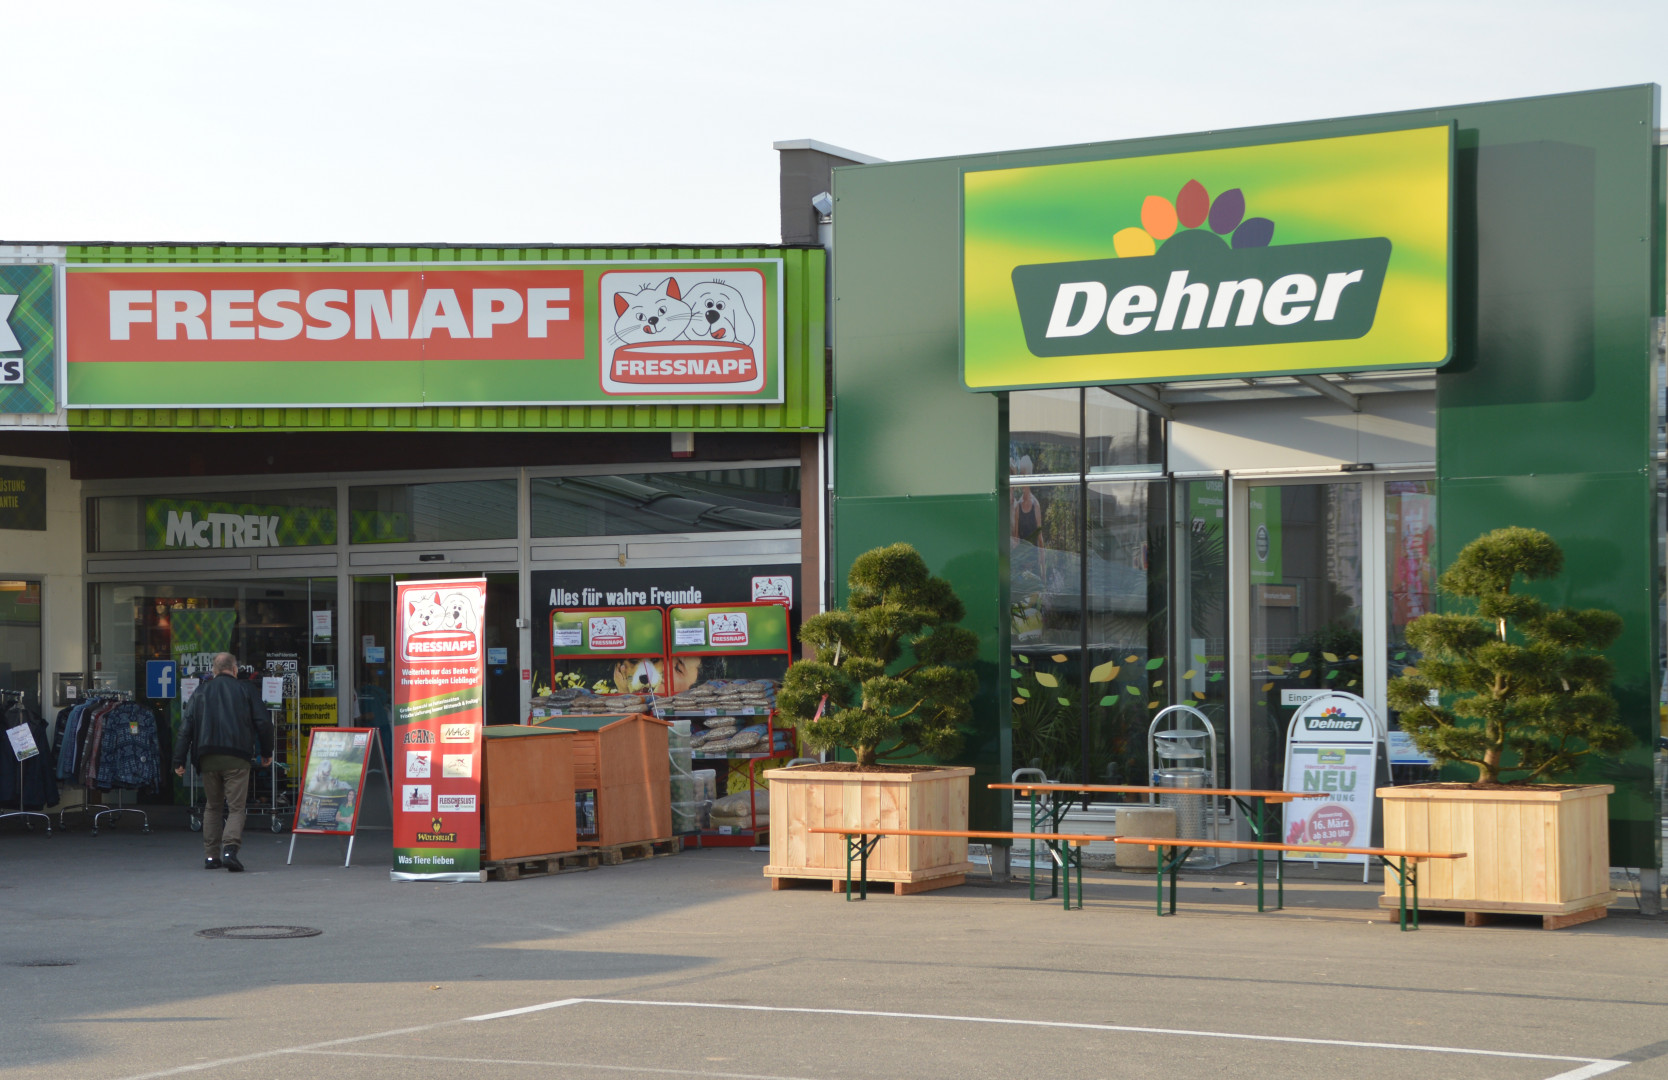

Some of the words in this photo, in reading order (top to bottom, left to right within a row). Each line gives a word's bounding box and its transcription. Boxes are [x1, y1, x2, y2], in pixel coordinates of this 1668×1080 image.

[1045, 269, 1364, 338] Dehner
[109, 288, 570, 340] FRESSNAPF
[615, 359, 752, 376] FRESSNAPF
[165, 510, 280, 548] McTREK
[549, 588, 579, 606] Alles
[582, 587, 602, 606] für
[606, 587, 646, 605] wahre
[650, 586, 702, 604] Freunde
[712, 635, 746, 643] FRESSNAPF
[408, 640, 475, 653] FRESSNAPF
[401, 668, 430, 676] Weiterhin
[441, 667, 451, 675] das
[453, 667, 468, 675] Beste
[1308, 718, 1360, 729] Dehner
[403, 729, 436, 745] ACANA
[1303, 769, 1357, 792] NEU
[1312, 820, 1326, 830] 16.
[1327, 818, 1350, 828] März
[1313, 831, 1322, 839] ab
[1322, 830, 1337, 839] 8.30
[1337, 829, 1350, 837] Uhr
[398, 855, 412, 864] Was
[413, 855, 431, 864] Tiere
[432, 855, 454, 865] lieben
